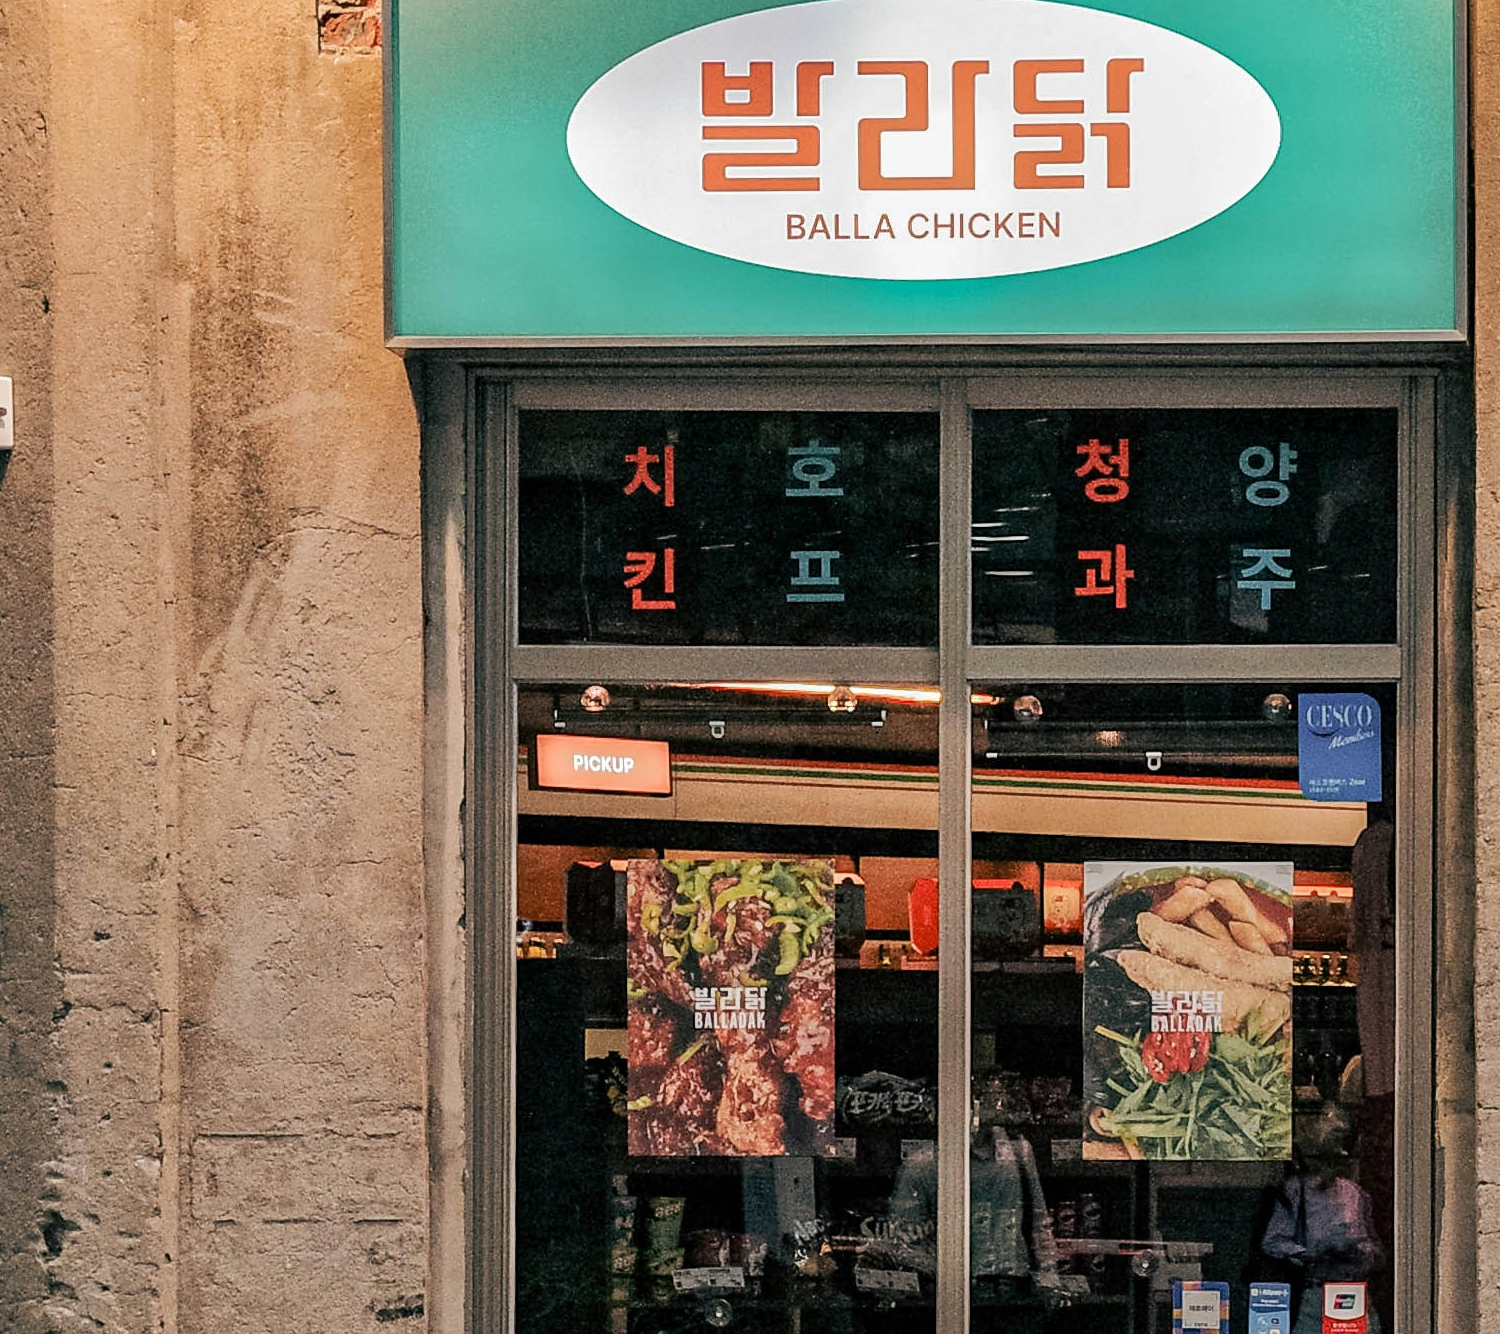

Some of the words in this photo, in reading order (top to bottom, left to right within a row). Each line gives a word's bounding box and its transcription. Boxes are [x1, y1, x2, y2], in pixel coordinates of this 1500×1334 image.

[701, 58, 1145, 192] 발라닭
[786, 212, 896, 240] BALLA
[907, 210, 1062, 239] CHICKEN
[1307, 705, 1372, 728] CESCO
[572, 754, 635, 774] PICKUP
[694, 986, 768, 1011] 발라닭
[694, 1011, 766, 1030] BALLADAK
[1151, 1014, 1223, 1033] BALLADAK
